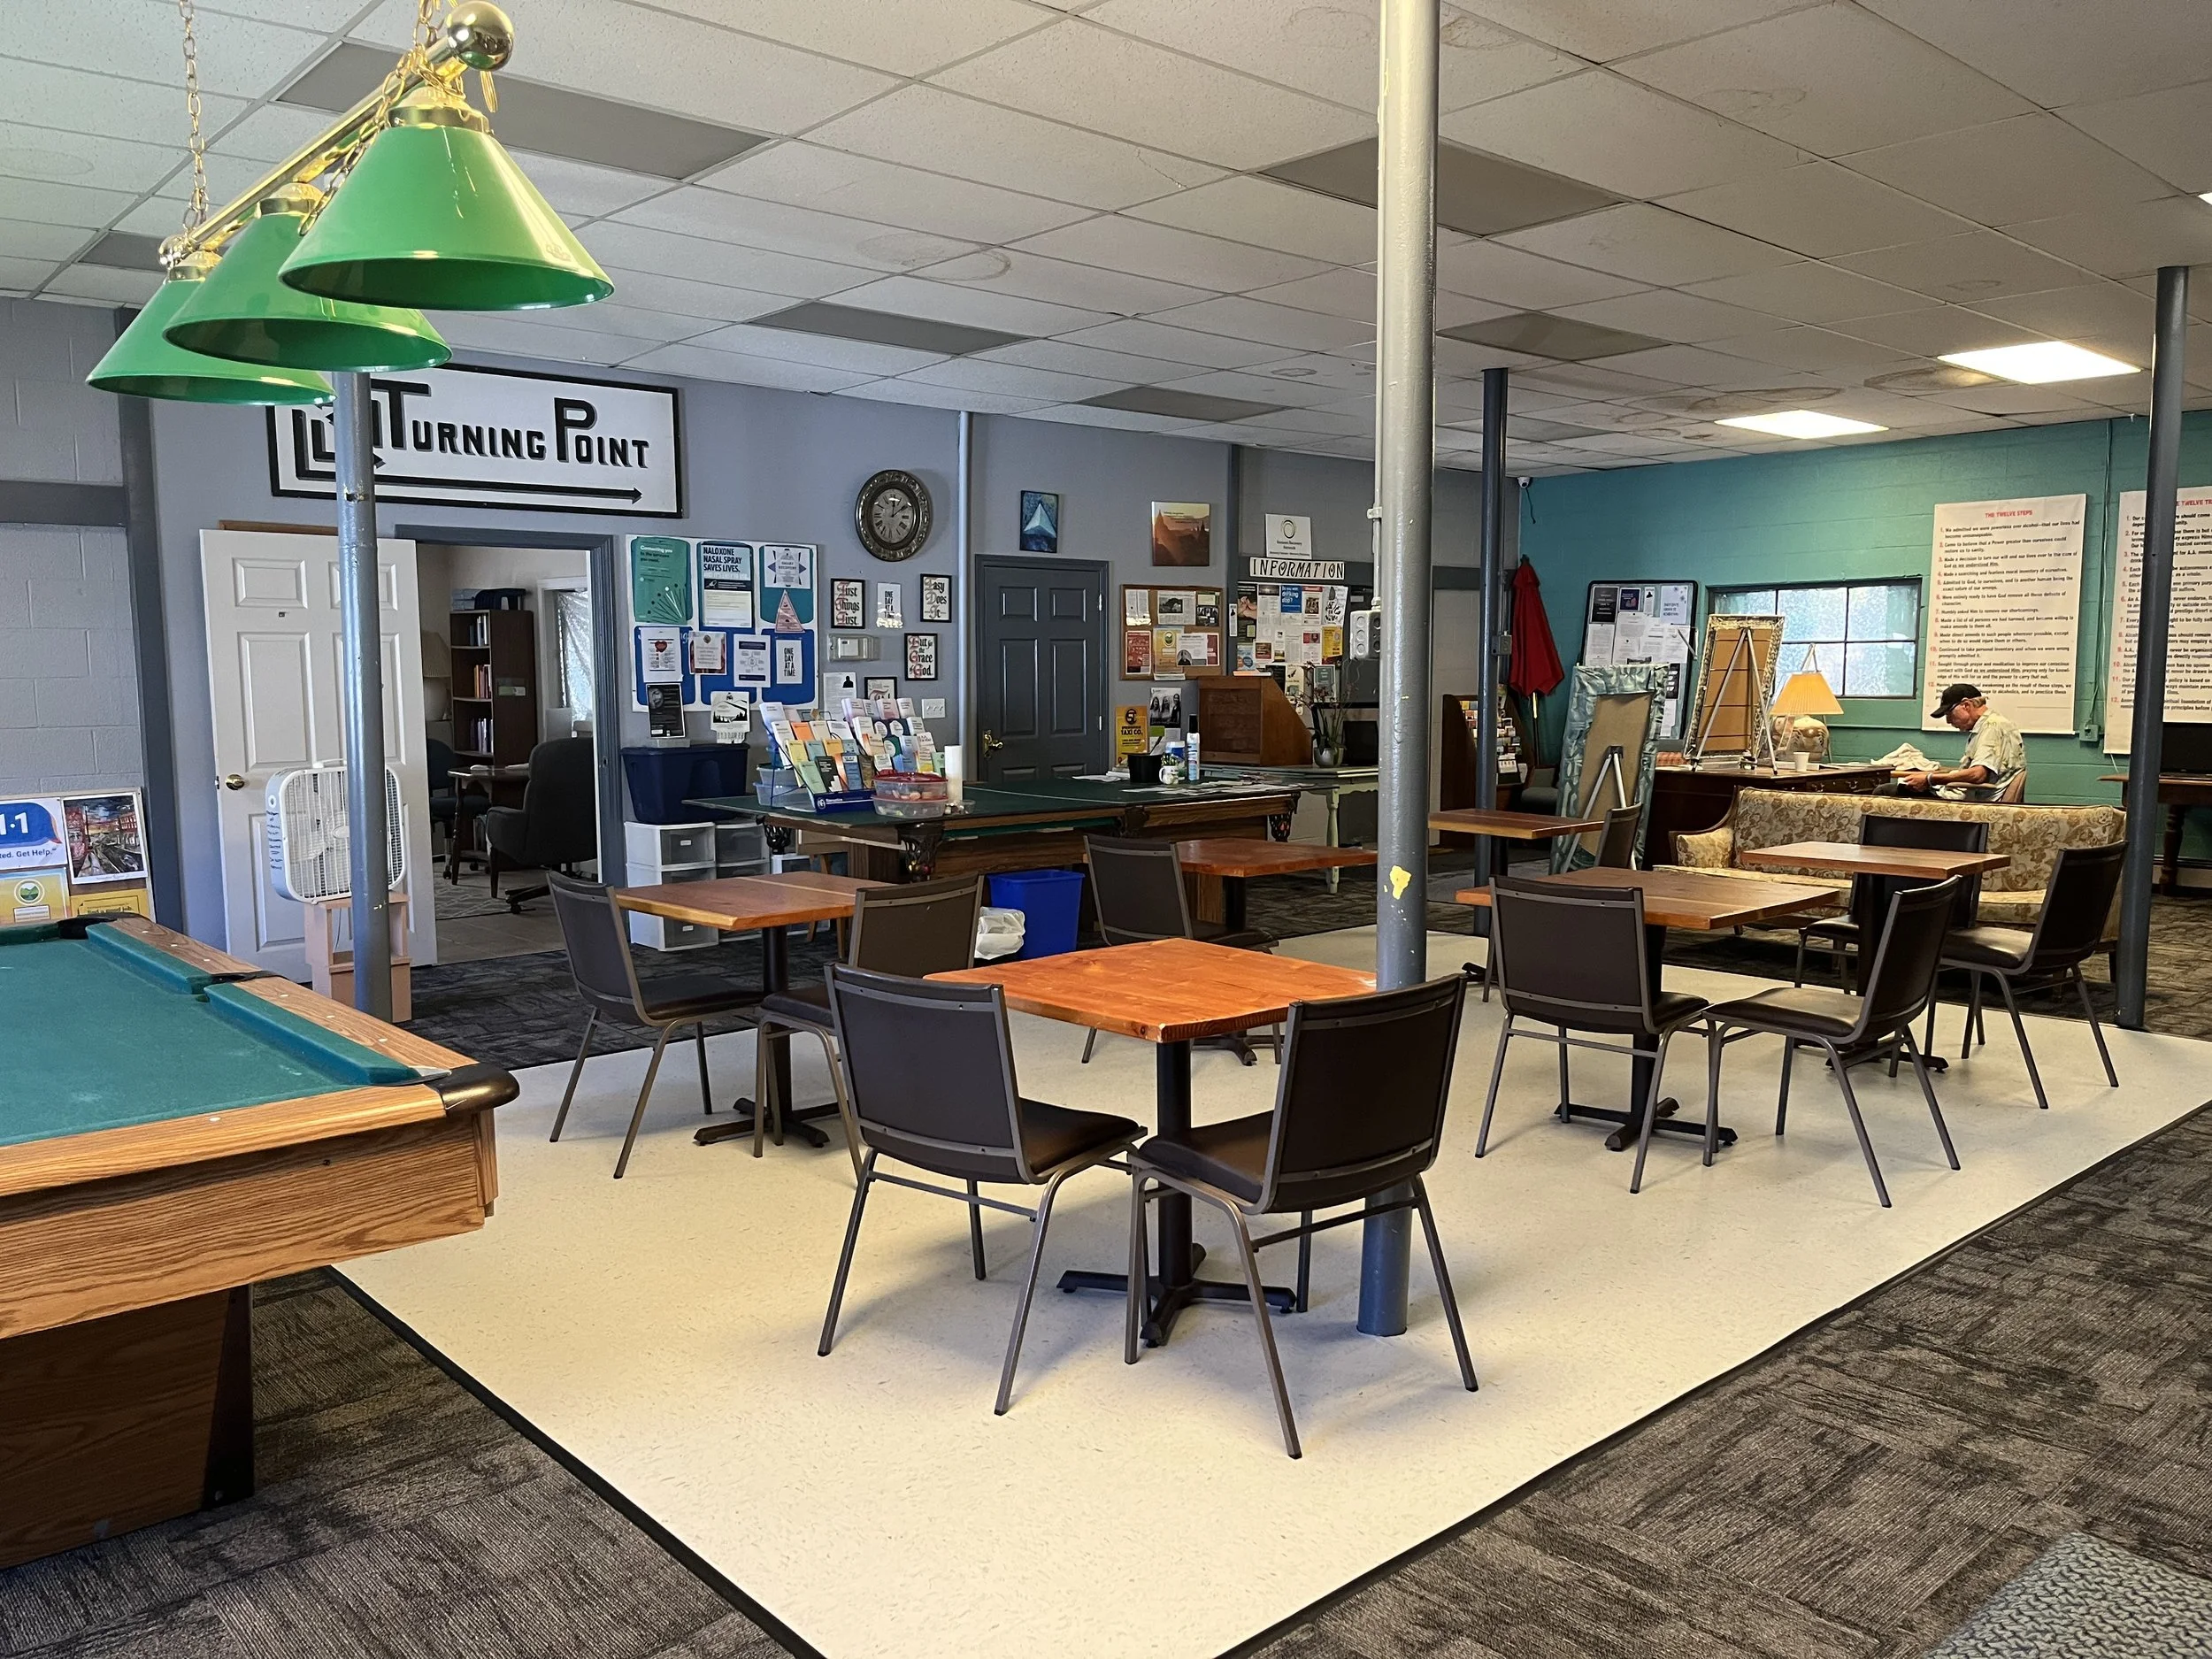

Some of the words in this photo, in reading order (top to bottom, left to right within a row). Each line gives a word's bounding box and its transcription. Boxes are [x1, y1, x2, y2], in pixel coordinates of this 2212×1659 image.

[371, 378, 546, 461] TURNING
[553, 396, 649, 468] POINT
[641, 545, 664, 554] Connecting
[703, 547, 734, 556] NALOXONE
[703, 563, 722, 572] SAVES
[1253, 558, 1344, 579] INFORMATION
[837, 581, 857, 597] First
[925, 577, 945, 594] Easy
[835, 597, 860, 614] Things
[926, 591, 947, 605] Does
[908, 635, 927, 649] But
[910, 649, 934, 664] Grace
